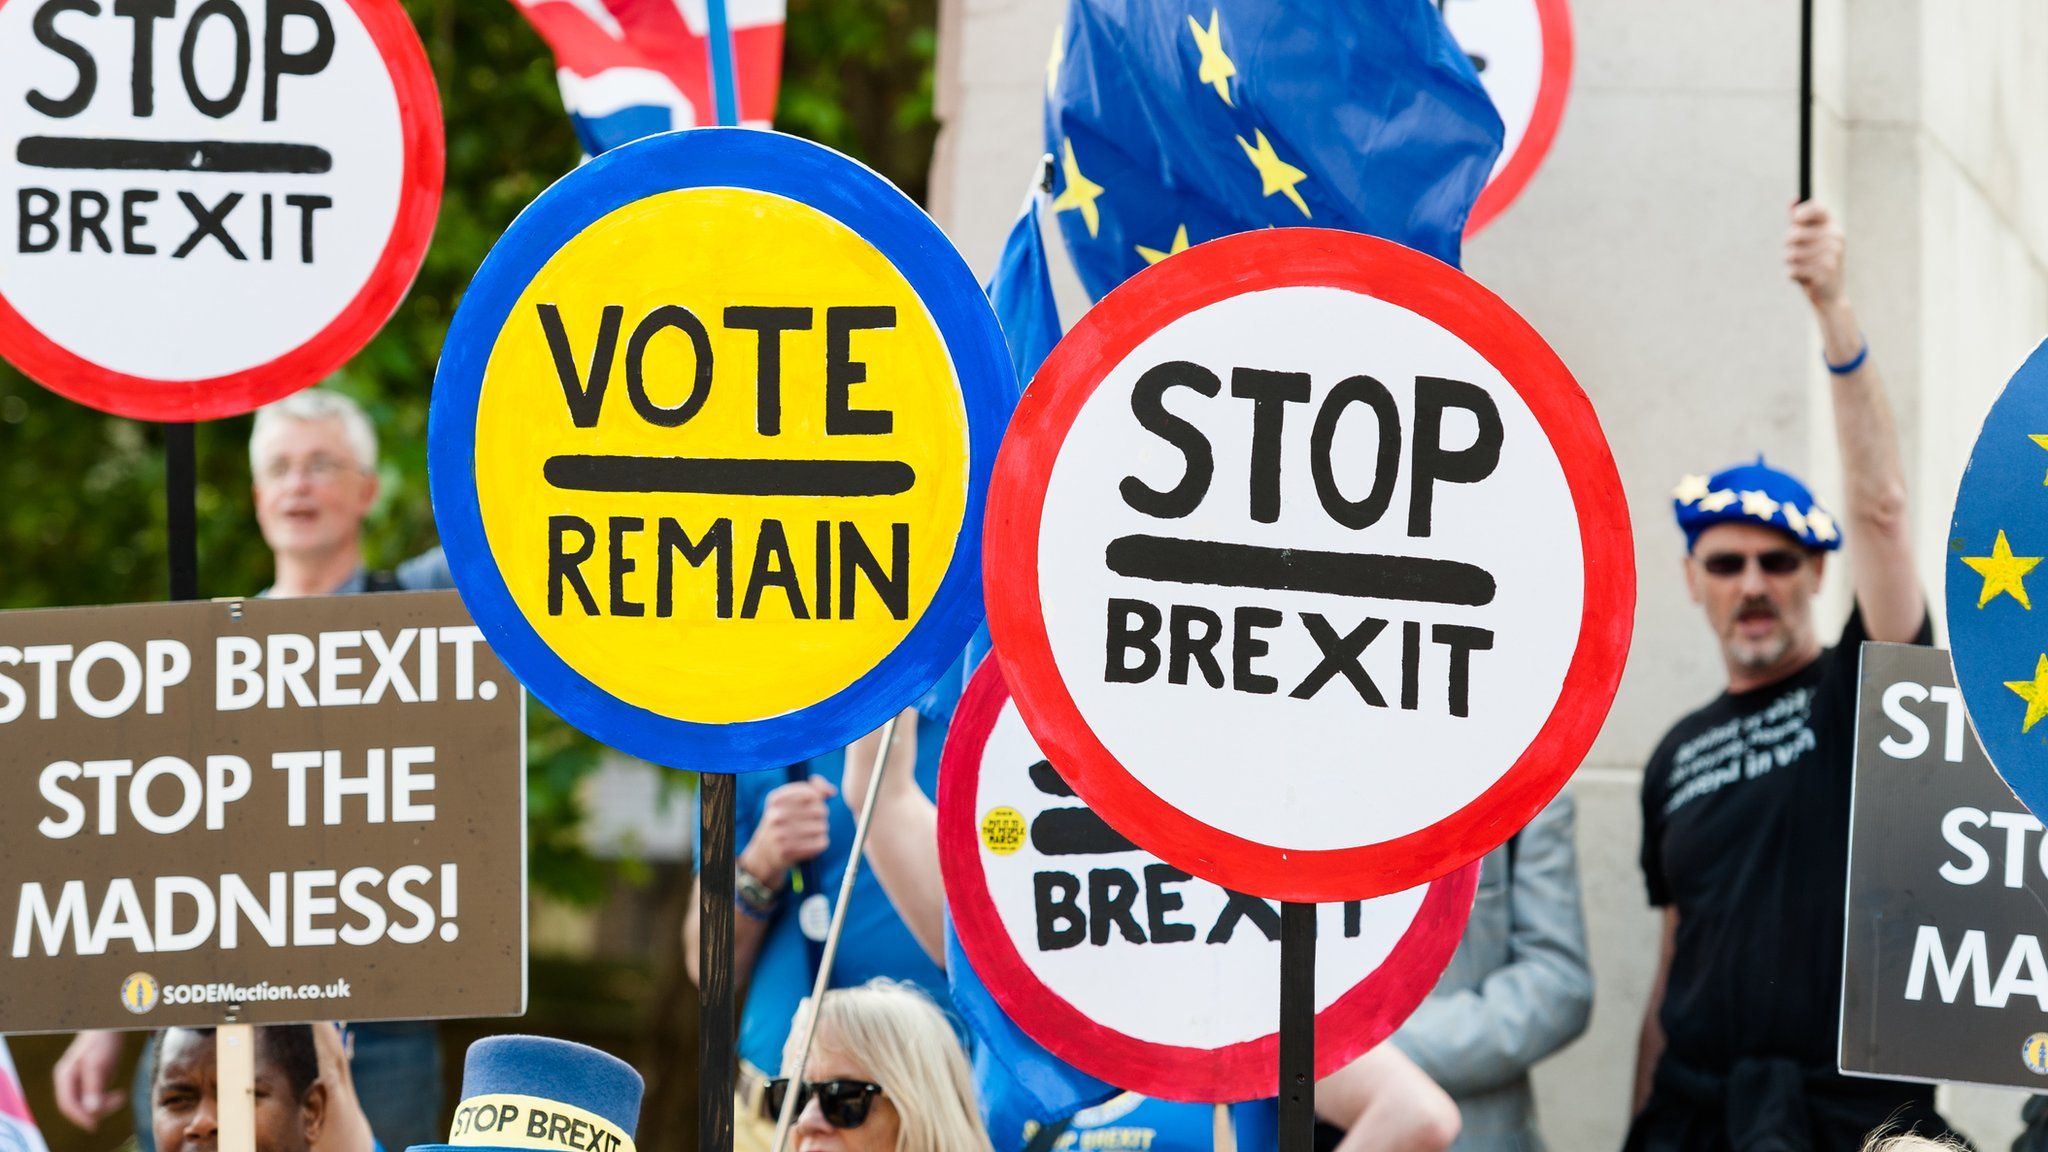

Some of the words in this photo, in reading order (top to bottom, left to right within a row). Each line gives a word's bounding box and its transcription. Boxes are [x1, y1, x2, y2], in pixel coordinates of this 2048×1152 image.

[25, 0, 336, 121] STOP
[17, 187, 333, 264] BREXIT
[536, 303, 897, 437] VOTE
[1118, 360, 1505, 537] STOP
[547, 515, 910, 621] REMAIN
[0, 639, 192, 724] STOP
[215, 625, 498, 711] BREXIT.
[1104, 597, 1495, 718] BREXIT
[1879, 681, 1966, 763] ST
[38, 754, 252, 839] STOP
[271, 746, 436, 827] THE
[12, 863, 459, 958] MADNESS!
[162, 977, 351, 1005] SODEMaction.co.uk
[454, 1103, 519, 1138] STOP
[525, 1108, 622, 1152] BREXIT
